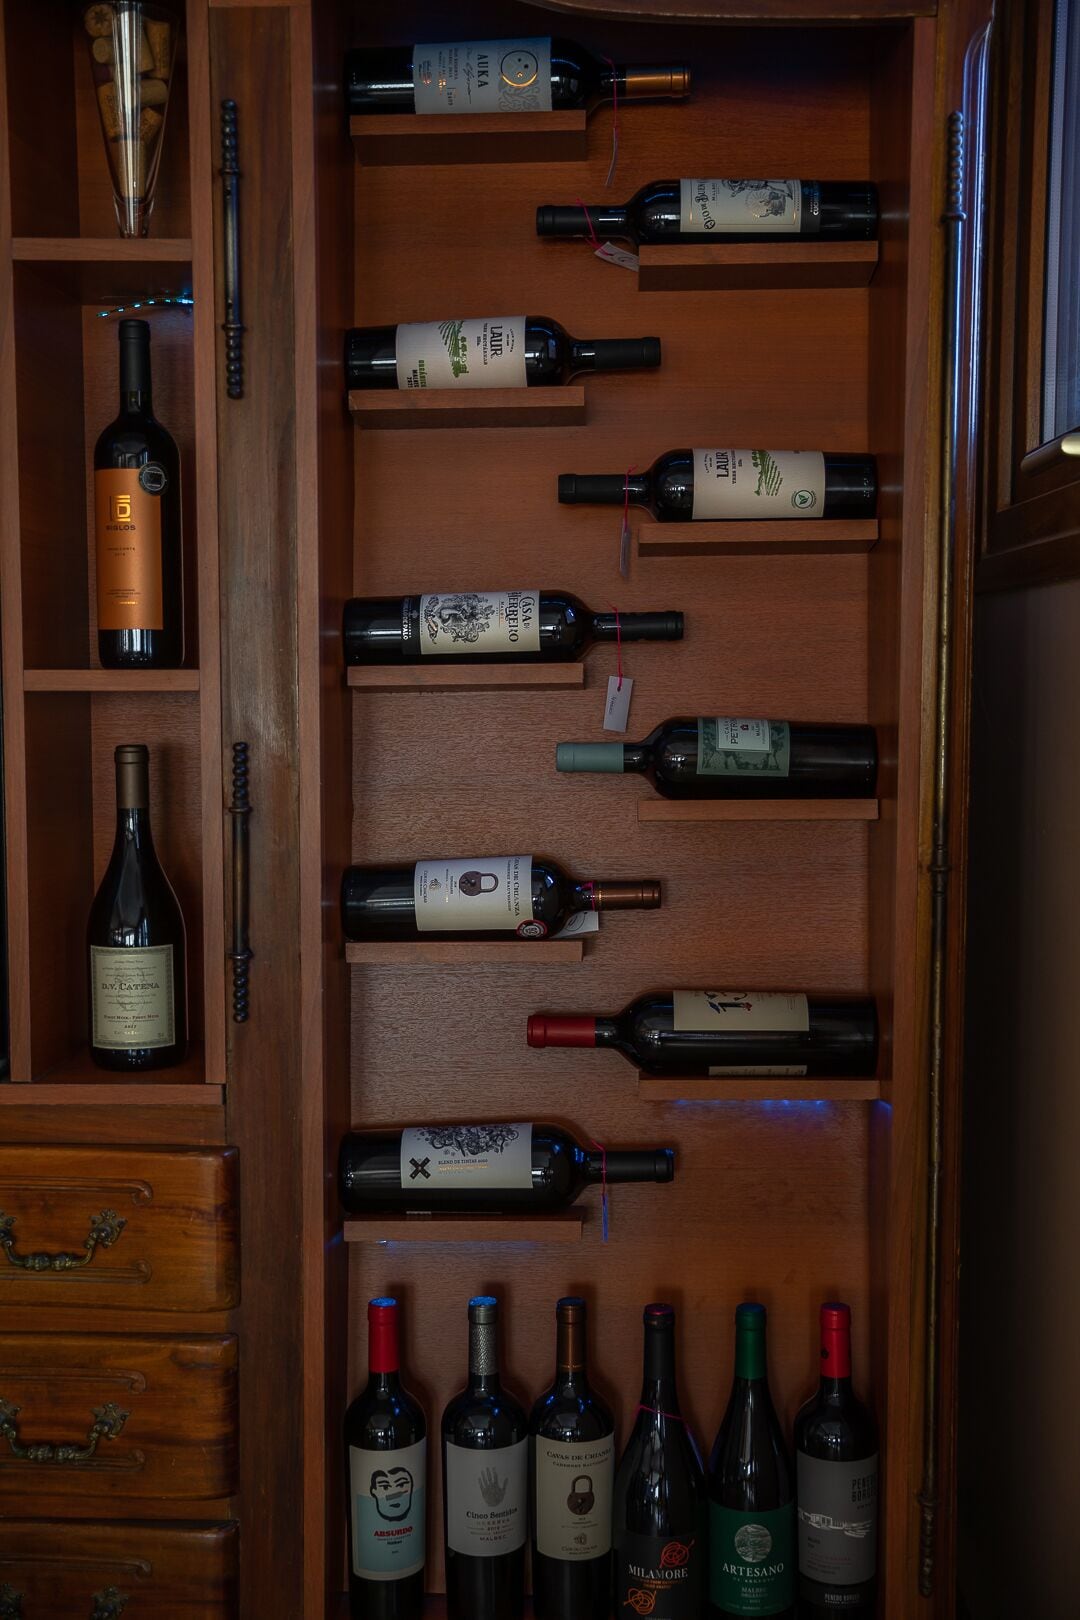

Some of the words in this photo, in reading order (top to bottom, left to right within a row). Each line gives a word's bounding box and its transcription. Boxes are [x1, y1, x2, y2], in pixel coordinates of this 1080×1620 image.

[478, 54, 488, 88] AUKA
[702, 210, 715, 229] OJO
[716, 452, 729, 478] LAUR
[519, 597, 535, 622] CASA
[513, 871, 520, 881] DE
[513, 882, 521, 917] CRIANZA
[119, 983, 159, 991] CATENA
[546, 1450, 570, 1460] CAVAS
[466, 1510, 488, 1519] Cinco
[490, 1508, 518, 1519] Sentidos
[374, 1526, 413, 1537] ABSURDO
[628, 1564, 688, 1579] MILAMORE
[722, 1562, 784, 1577] ARTESANO
